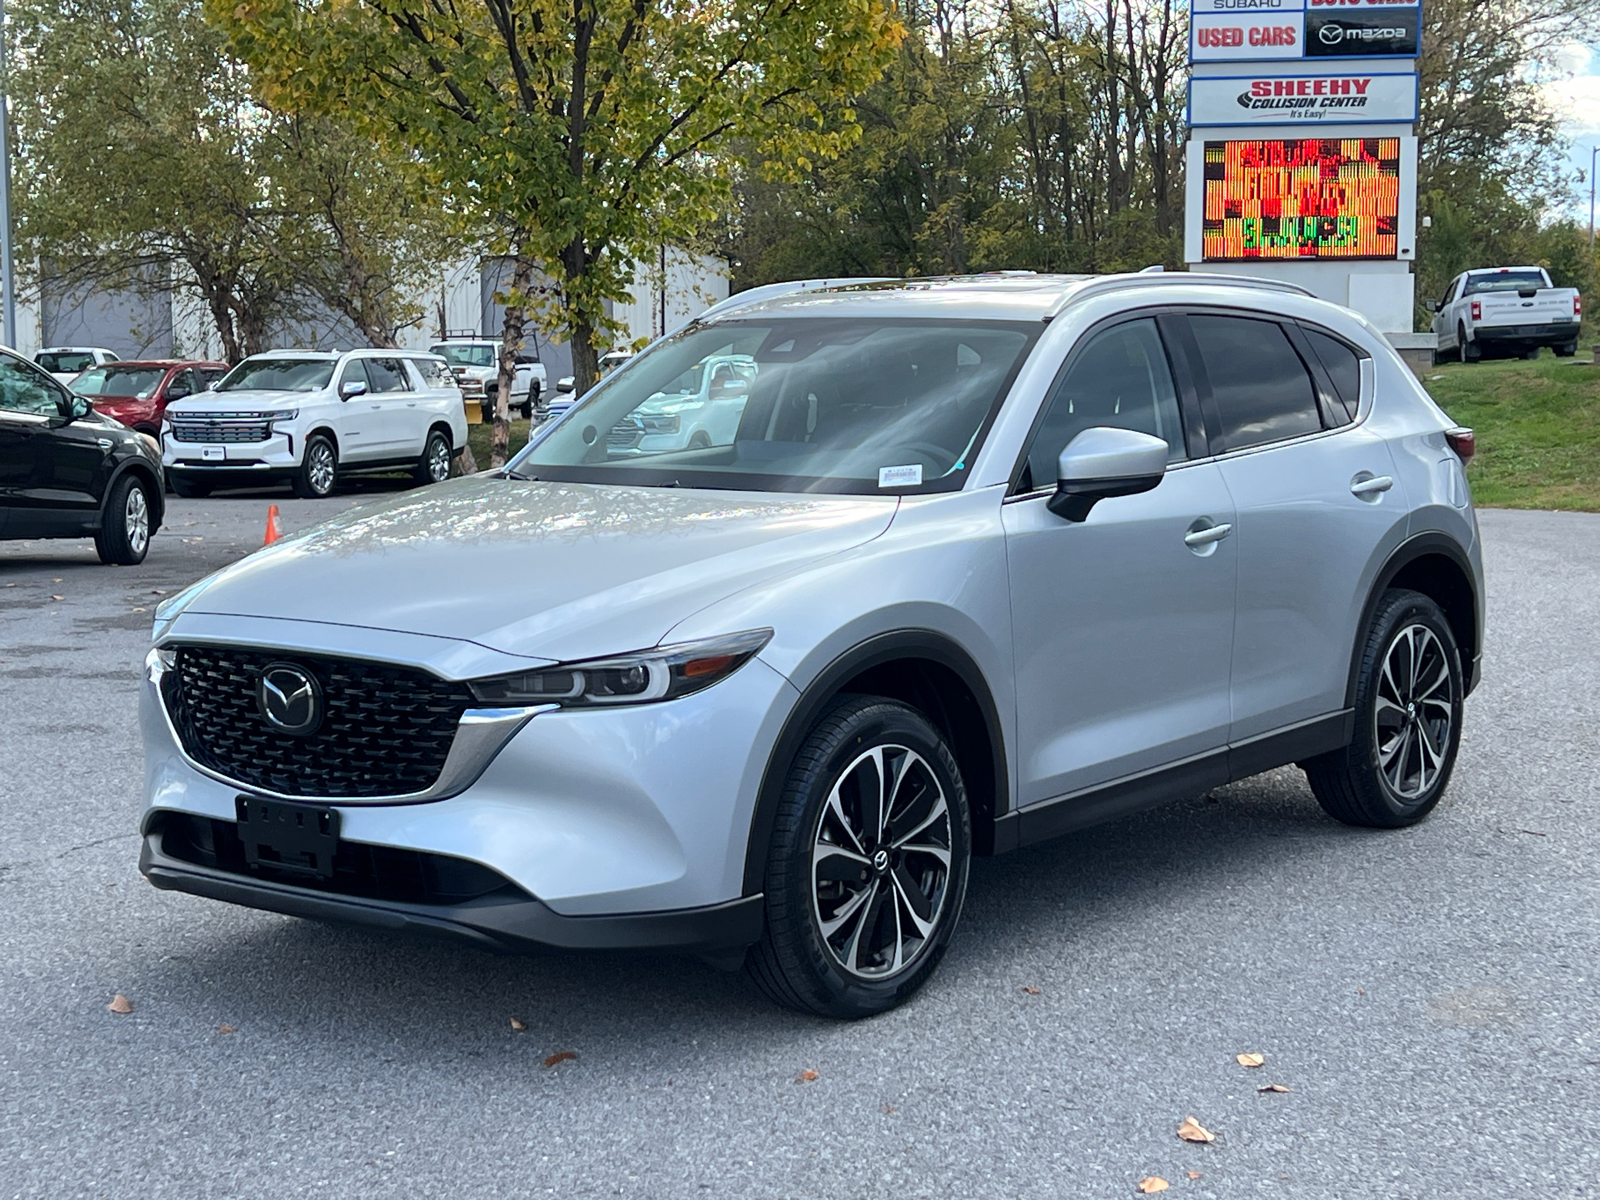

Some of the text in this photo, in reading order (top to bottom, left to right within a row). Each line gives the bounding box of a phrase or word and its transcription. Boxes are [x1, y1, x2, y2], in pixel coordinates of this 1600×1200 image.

[1213, 0, 1282, 9] SUBARU
[1198, 26, 1296, 48] USED CARS
[1346, 28, 1406, 40] mazda
[1251, 79, 1371, 97] SHEEHY
[1251, 96, 1368, 109] COLLISION CENTER
[1290, 109, 1327, 119] It's Easy!
